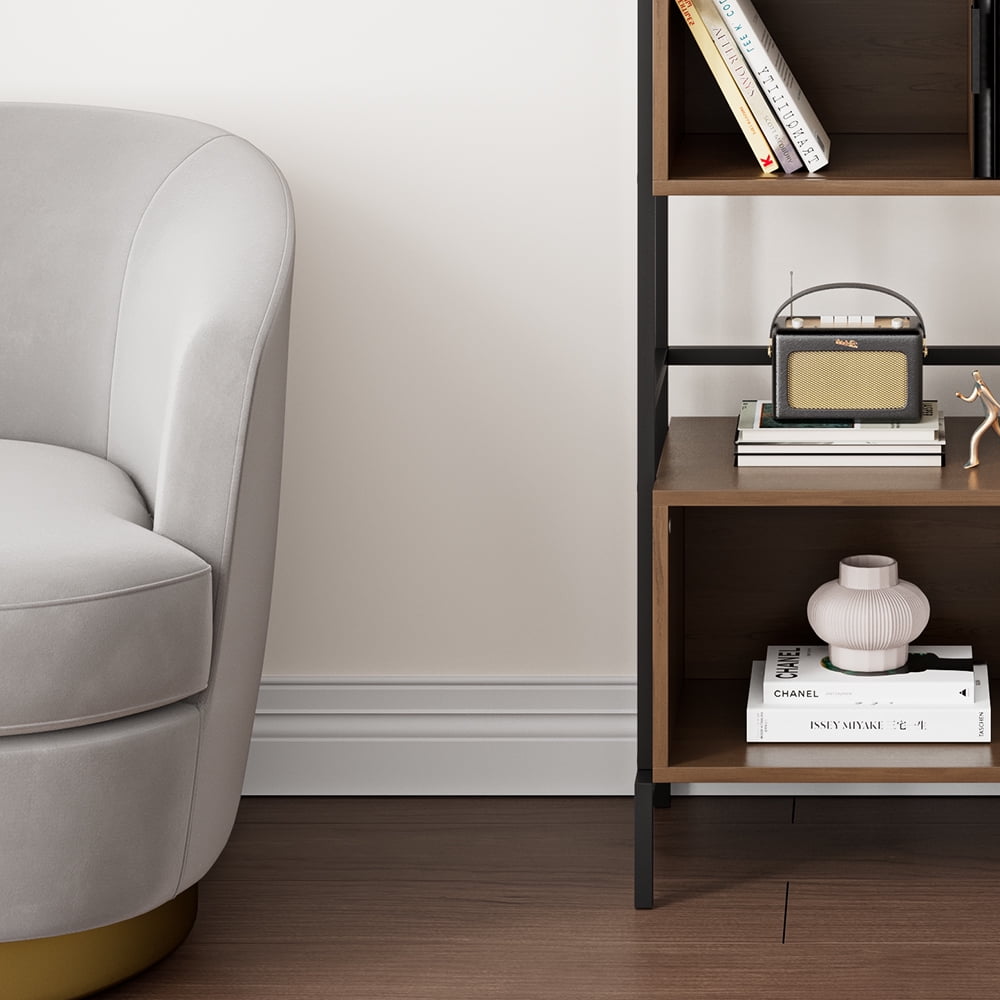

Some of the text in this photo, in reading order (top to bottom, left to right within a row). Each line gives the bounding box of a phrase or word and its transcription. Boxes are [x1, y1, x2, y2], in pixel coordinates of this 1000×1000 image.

[735, 66, 757, 97] DAYS
[775, 647, 801, 680] CHANEL
[810, 720, 883, 730] ISSEY MIYAKE
